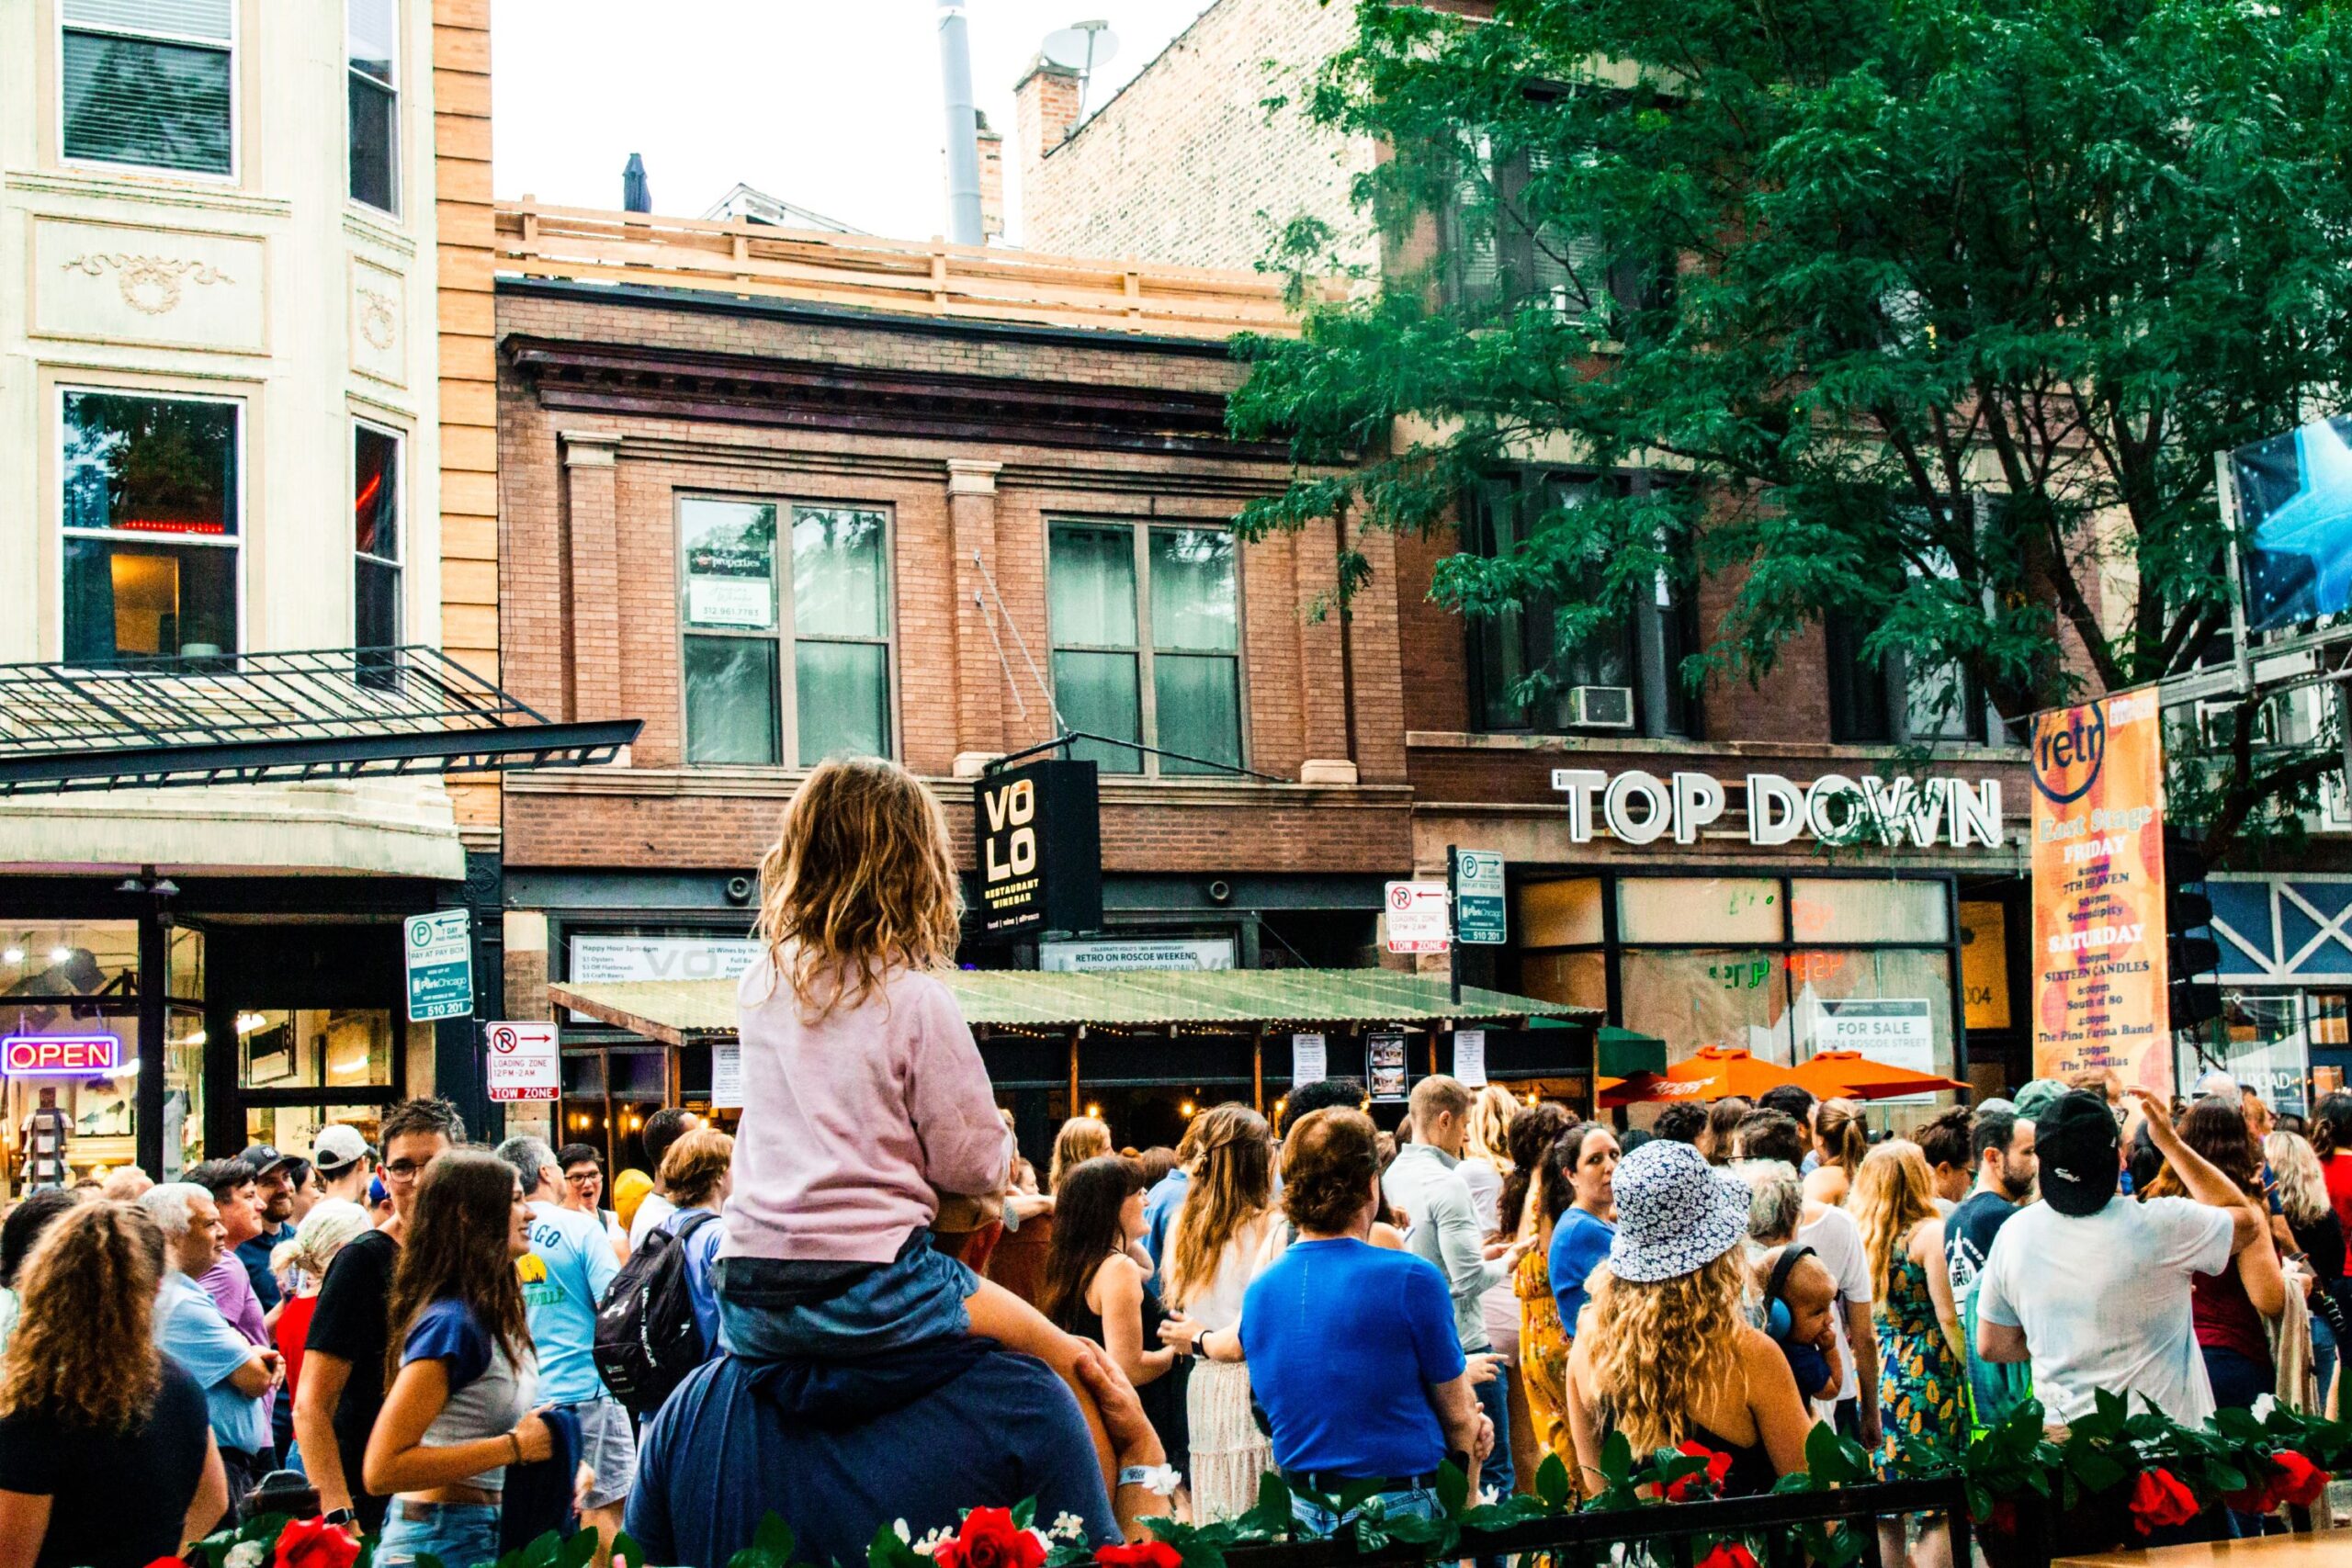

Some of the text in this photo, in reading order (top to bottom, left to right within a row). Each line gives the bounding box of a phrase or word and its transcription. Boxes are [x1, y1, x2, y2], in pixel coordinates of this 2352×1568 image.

[1552, 770, 2002, 849] TOP DOWN
[2040, 805, 2154, 842] East Stage
[2064, 835, 2128, 863] FRIDAY
[985, 878, 1039, 899] RESTAURANT
[2085, 873, 2130, 889] HEAVEN
[2068, 905, 2124, 922] Serendipity
[1474, 931, 1487, 941] 510
[1487, 931, 1500, 942] 201
[2049, 923, 2145, 953] SATURDAY
[449, 946, 464, 954] BOX
[1394, 941, 1443, 950] TOW ZONE
[1105, 953, 1119, 962] ON
[1157, 952, 1198, 961] WEEKEND
[2044, 961, 2150, 982] SIXTEEN CANDLES
[421, 976, 467, 990] ParkChicago
[427, 1004, 445, 1017] 510
[447, 1001, 463, 1014] 201
[2067, 998, 2094, 1010] South
[1837, 1021, 1911, 1035] FOR SALE
[2039, 1032, 2057, 1043] The
[2121, 1023, 2154, 1035] Band
[1849, 1038, 1890, 1048] ROSCOE
[1892, 1038, 1927, 1047] STREET
[9, 1043, 110, 1068] OPEN
[493, 1059, 548, 1067] LOADING ZONE
[2060, 1060, 2080, 1072] The
[494, 1088, 553, 1099] TOW ZONE
